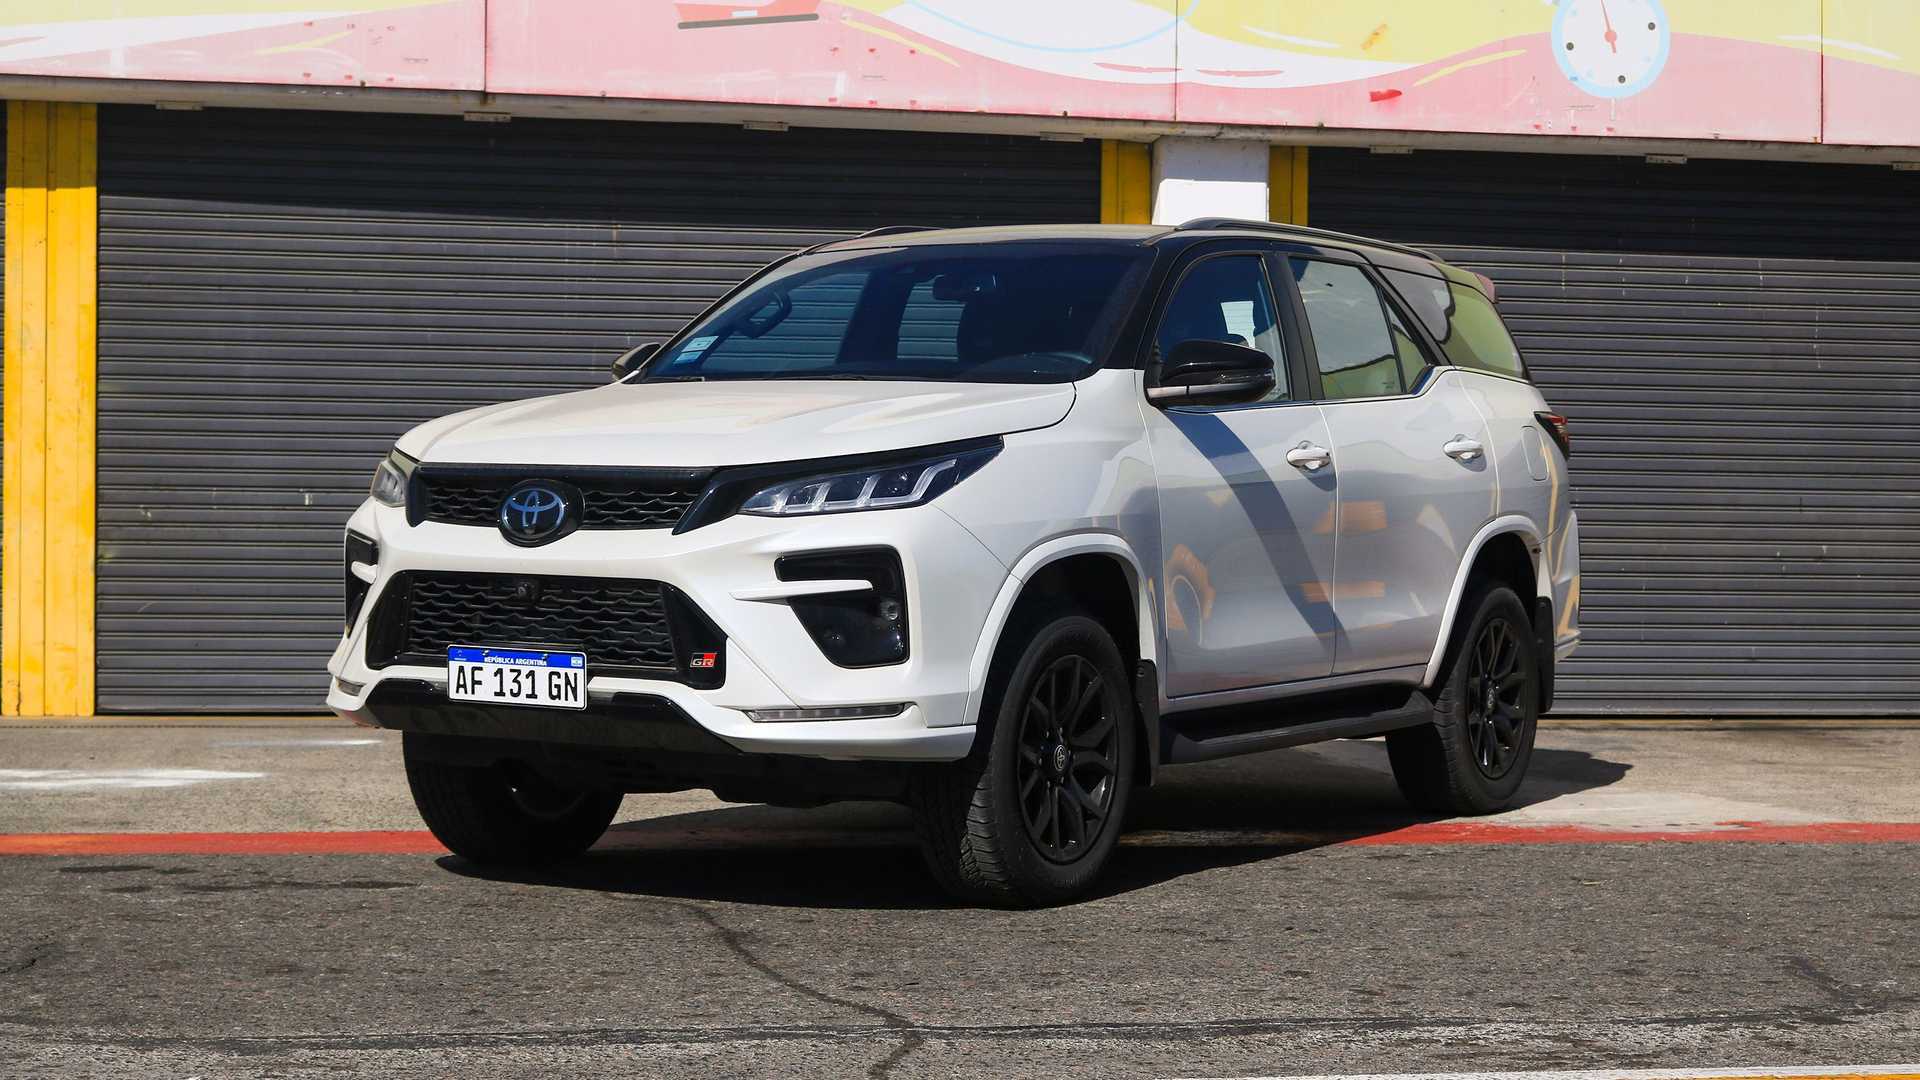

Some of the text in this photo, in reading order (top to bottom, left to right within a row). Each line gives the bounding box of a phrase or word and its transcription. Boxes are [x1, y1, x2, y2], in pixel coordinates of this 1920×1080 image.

[484, 656, 514, 664] REPÚBLICA
[692, 658, 715, 667] GR
[456, 665, 578, 702] AF 131 GN
